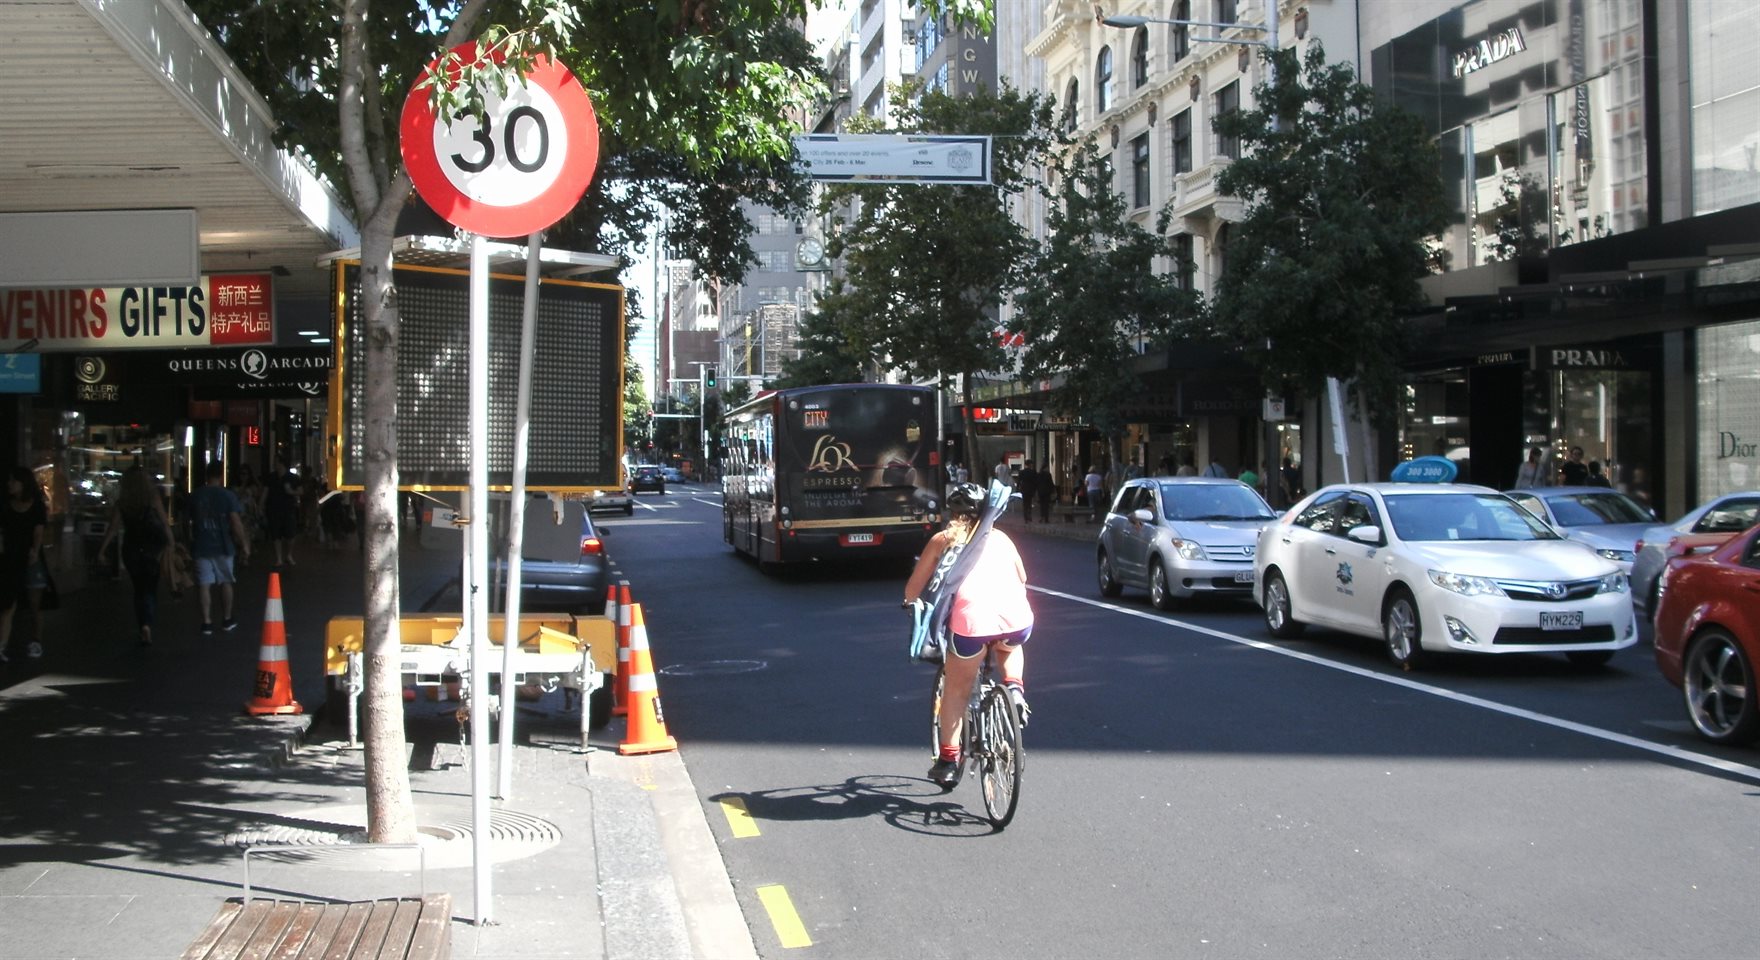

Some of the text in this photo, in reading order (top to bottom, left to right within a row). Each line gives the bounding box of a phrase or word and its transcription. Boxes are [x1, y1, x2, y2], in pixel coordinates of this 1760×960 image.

[1453, 28, 1527, 79] PRADA
[451, 105, 549, 173] 30
[218, 284, 263, 307] 新西兰
[119, 287, 206, 338] GIFTS
[211, 311, 271, 334] 特产礼品
[169, 359, 237, 372] QUEENS
[1552, 349, 1627, 366] PRADA
[77, 384, 119, 393] GALLERY
[77, 393, 119, 401] PACIFIC
[804, 411, 829, 427] CITY
[1010, 415, 1036, 430] Hair
[1717, 431, 1758, 459] Dior
[803, 477, 862, 487] ESPRESSO
[804, 498, 863, 509] THE AROMA
[1542, 614, 1581, 626] HYM229
